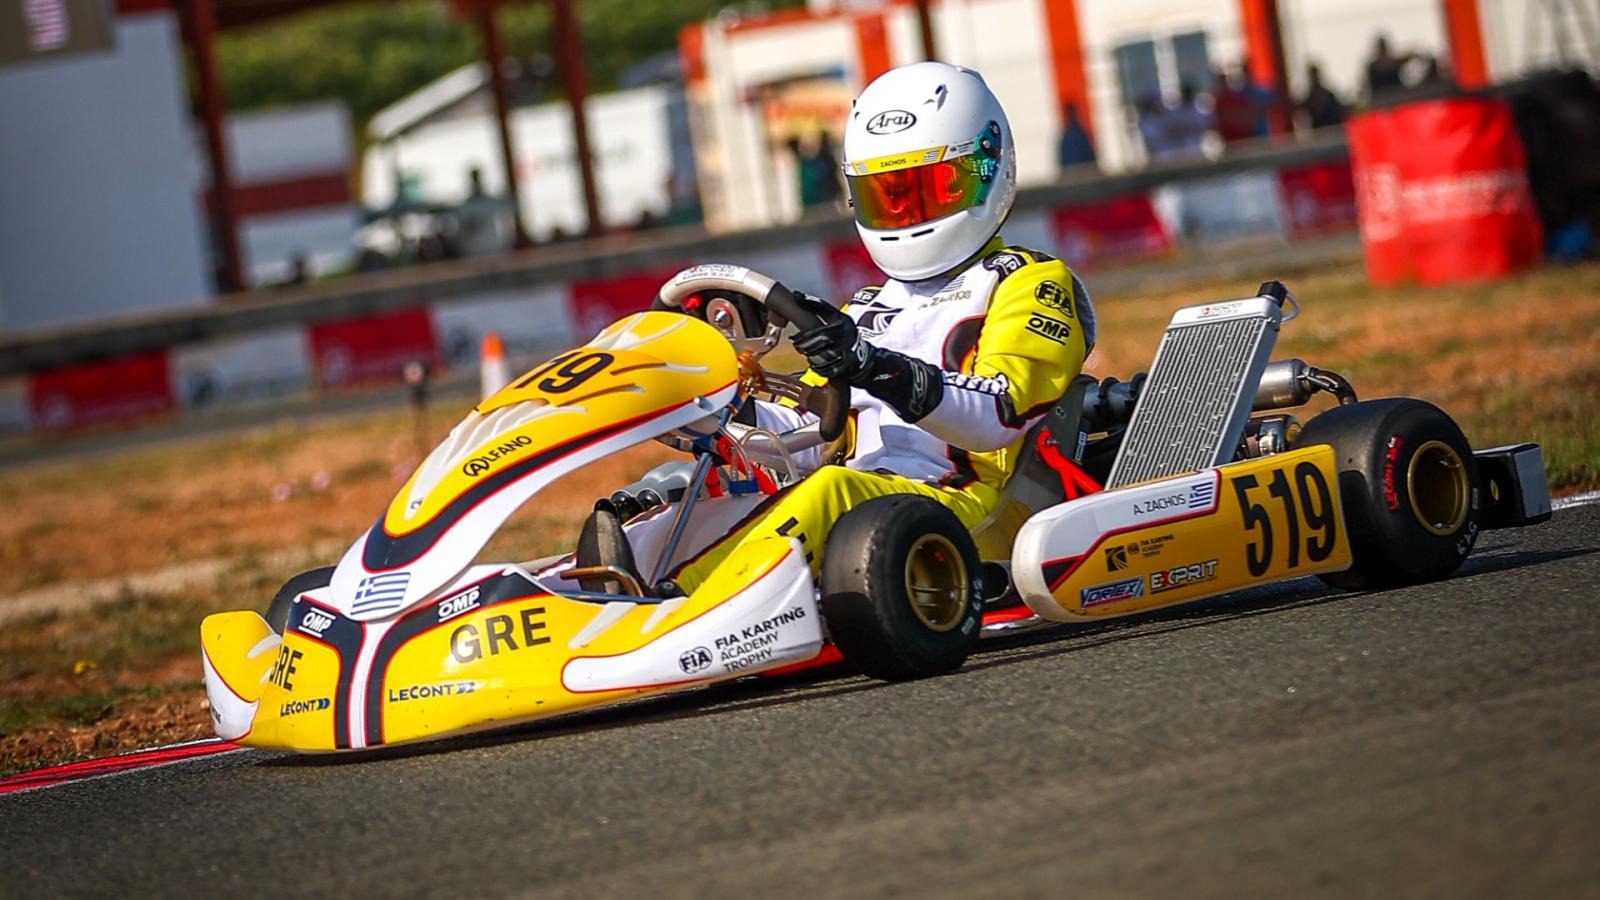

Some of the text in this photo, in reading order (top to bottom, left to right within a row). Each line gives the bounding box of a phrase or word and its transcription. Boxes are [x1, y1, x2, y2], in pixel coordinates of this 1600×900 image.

[873, 113, 911, 128] Arai
[880, 158, 907, 168] ZACHOS
[1027, 316, 1070, 340] OMP
[463, 435, 532, 477] ALFANO
[1145, 493, 1186, 514] ZACHOS
[1232, 461, 1336, 577] 519
[1151, 561, 1217, 589] EXPRIT
[438, 590, 480, 618] OMP
[1082, 580, 1138, 606] VORTEX
[302, 611, 333, 634] OMP
[450, 606, 552, 664] GRE
[715, 607, 806, 650] FIA KARTING
[681, 649, 711, 670] FIA
[720, 631, 779, 662] ACADEMY
[724, 647, 773, 673] TROPHY
